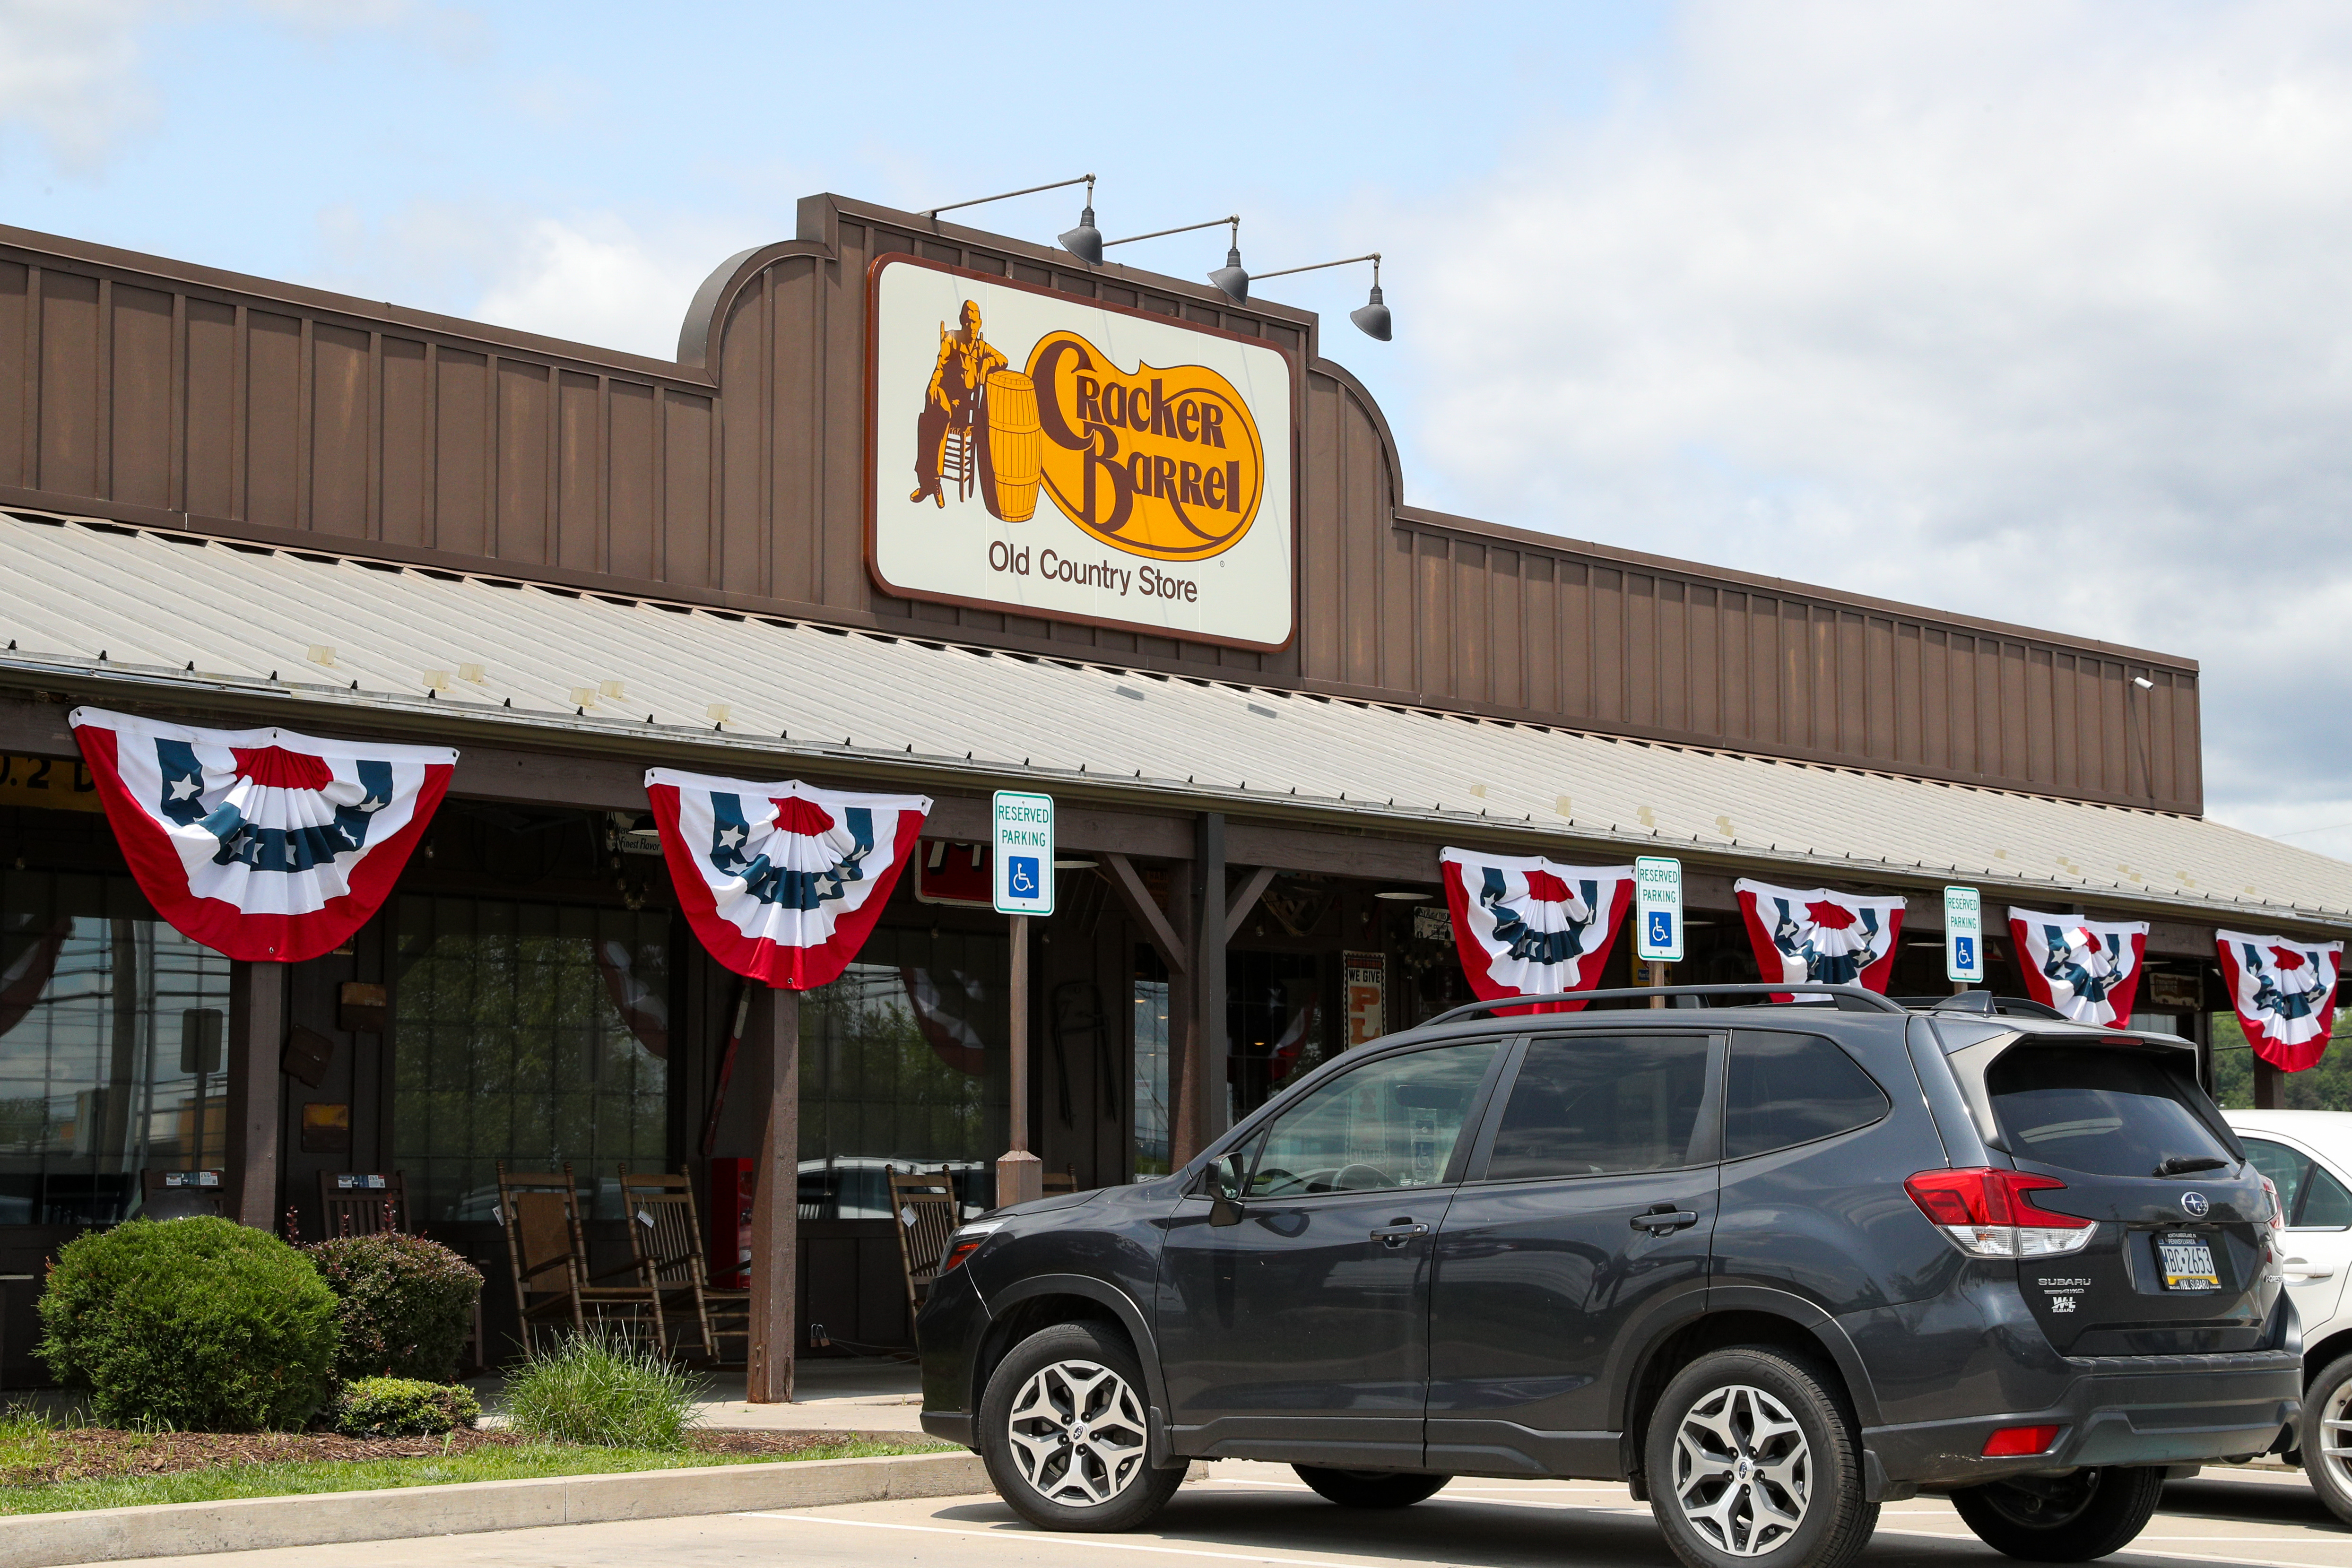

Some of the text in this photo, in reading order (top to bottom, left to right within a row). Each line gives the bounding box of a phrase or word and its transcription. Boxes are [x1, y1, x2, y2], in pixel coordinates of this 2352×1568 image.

[1031, 340, 1227, 450] Cracker
[1083, 421, 1241, 532] Barrel
[989, 540, 1198, 603] Old Country Store
[998, 805, 1049, 823] RESERVED
[621, 836, 660, 850] Finest Flavor
[1002, 829, 1046, 847] PARKING
[1640, 868, 1678, 883] RESERVED
[1643, 889, 1676, 903] PARKING
[1948, 897, 1978, 911] RESERVED
[1951, 916, 1977, 929] PARKING
[1349, 970, 1380, 983] WE GIVE
[2190, 1279, 2209, 1290] SUBARU
